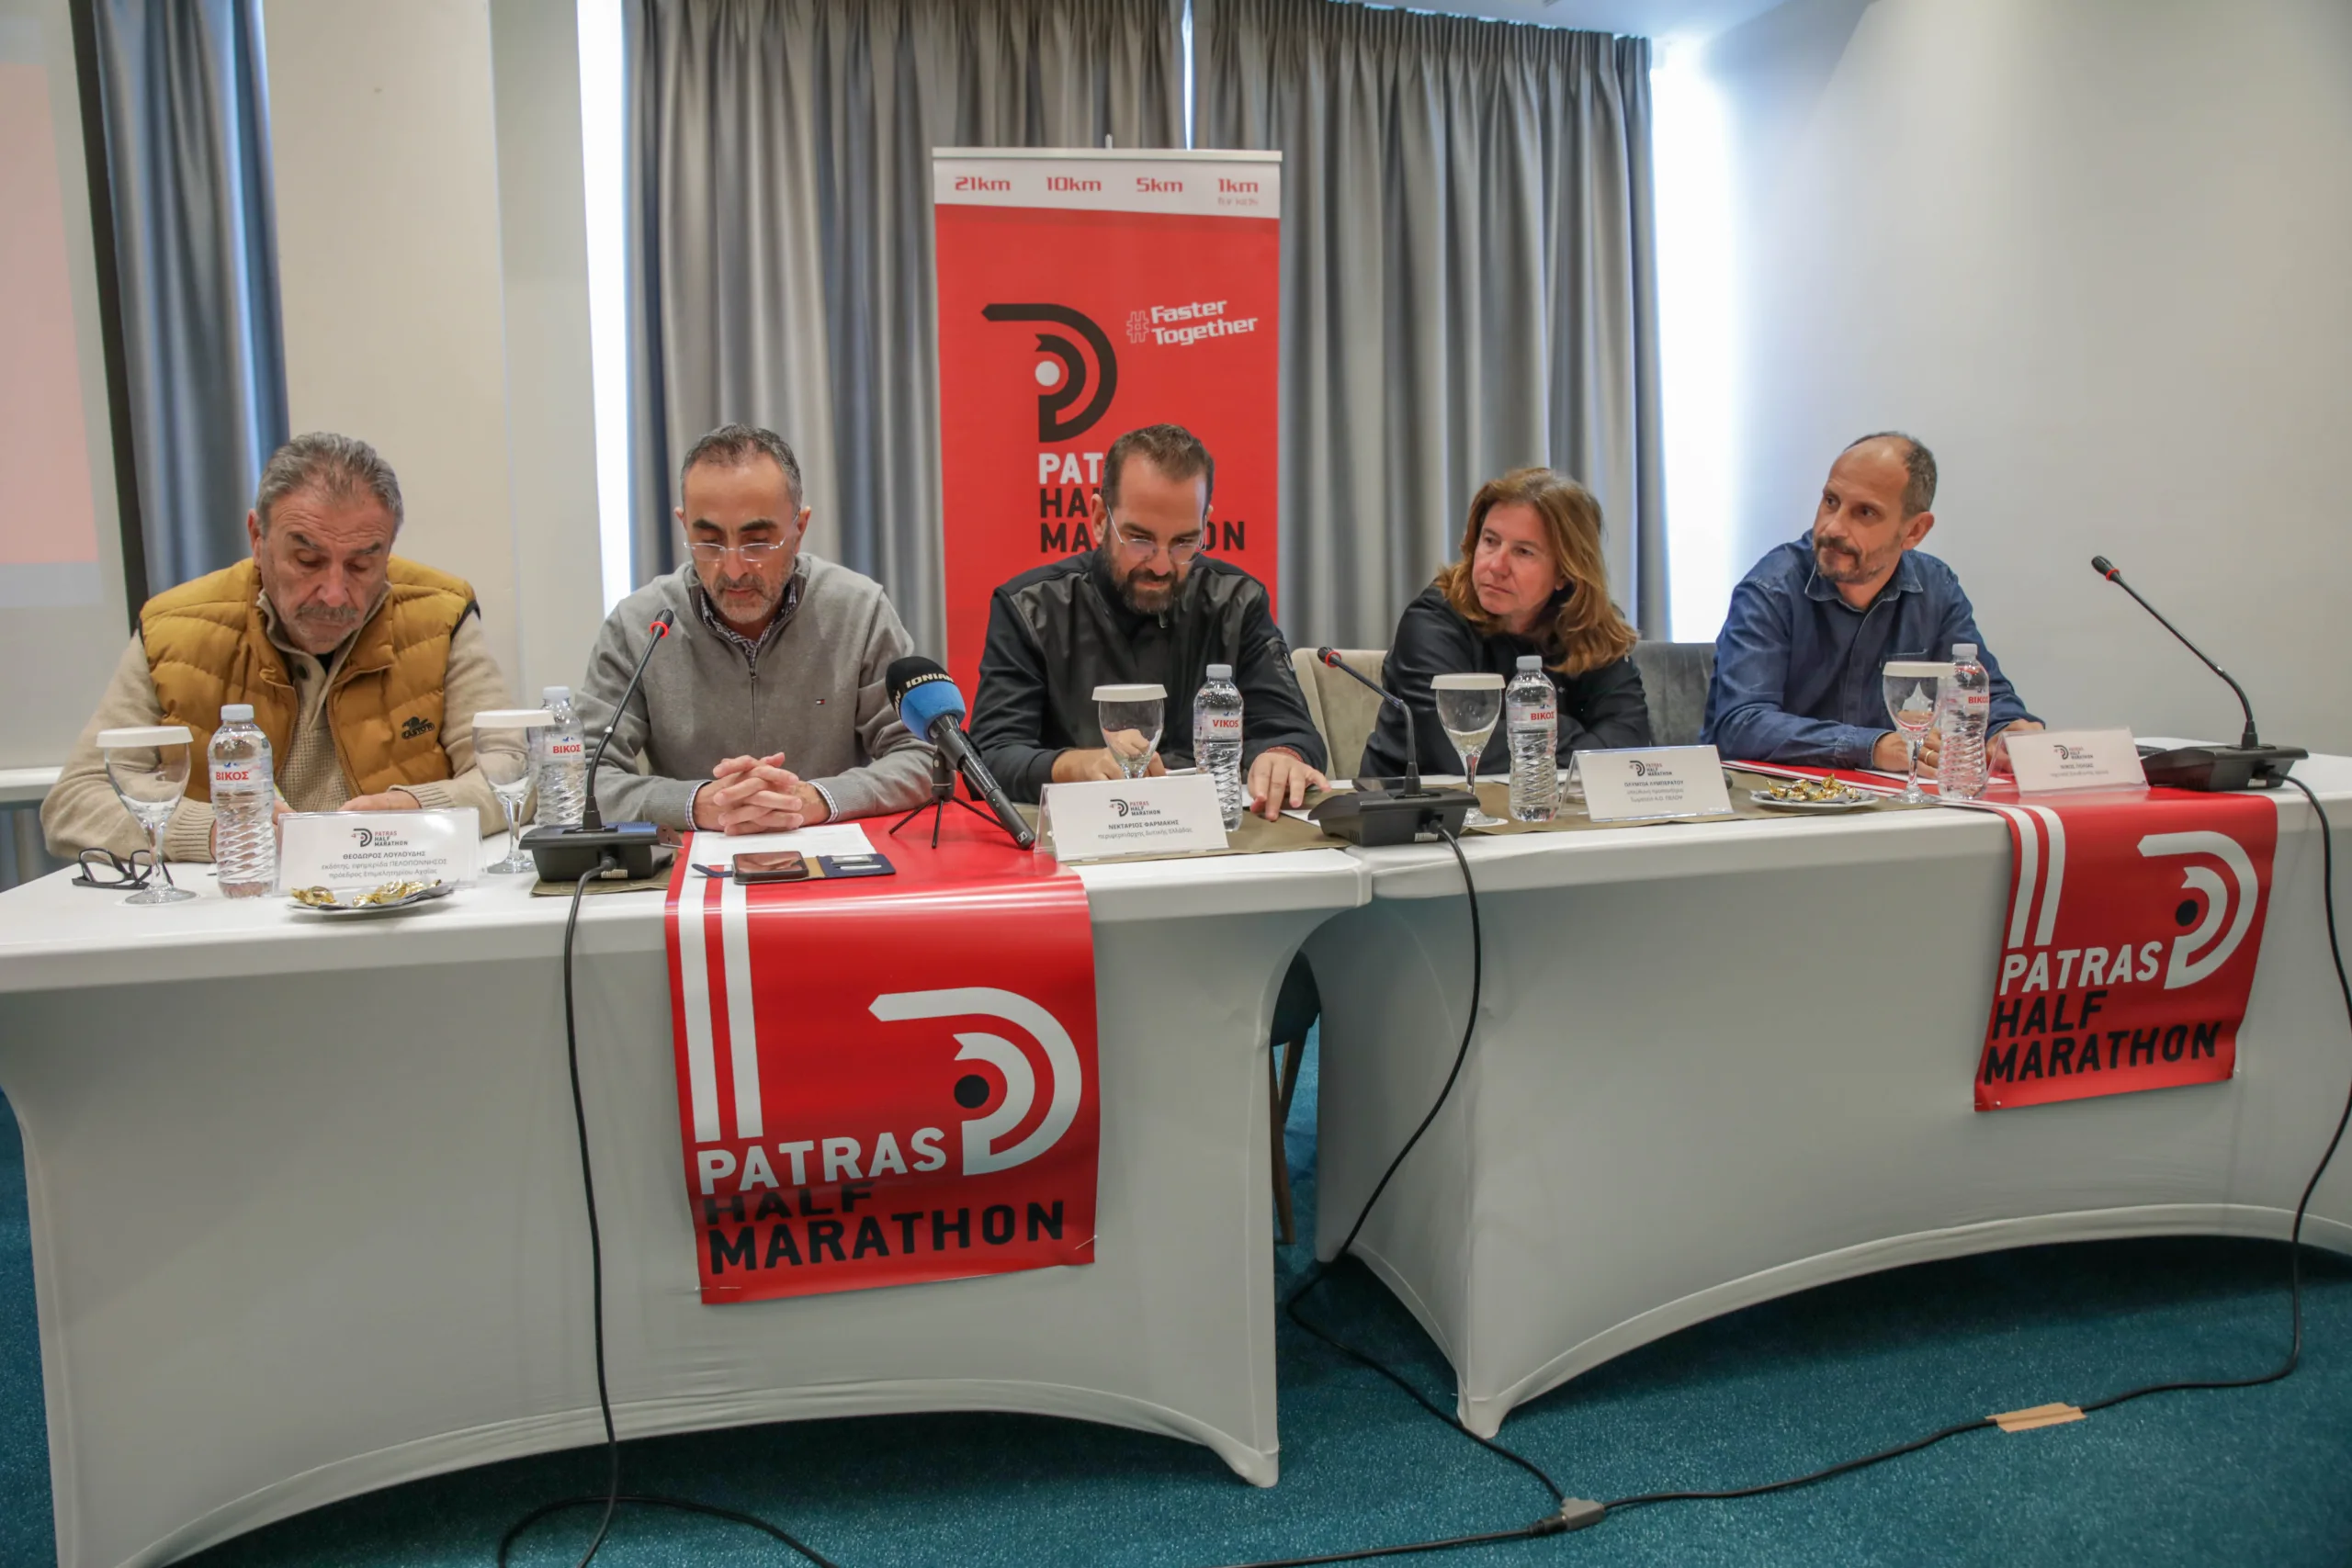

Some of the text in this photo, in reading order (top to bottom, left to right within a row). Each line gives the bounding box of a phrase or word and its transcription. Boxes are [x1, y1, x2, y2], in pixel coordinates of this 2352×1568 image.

[955, 176, 1259, 193] 21km 10km 5km 1km
[1150, 300, 1227, 323] Faster
[1151, 317, 1258, 345] Together
[1038, 453, 1103, 484] PAT
[1040, 488, 1100, 518] HA
[1213, 719, 1239, 728] VIKOS
[552, 744, 581, 754] ΒΙΚΟΣ
[216, 771, 249, 781] ΒΙΚΟΣ
[1999, 941, 2163, 996] PATRAS
[1992, 989, 2108, 1040] HALF
[1984, 1021, 2222, 1085] MARATHON
[697, 1127, 947, 1194] PATRAS
[704, 1181, 876, 1225] HALF
[707, 1201, 1065, 1274] MARATHON
